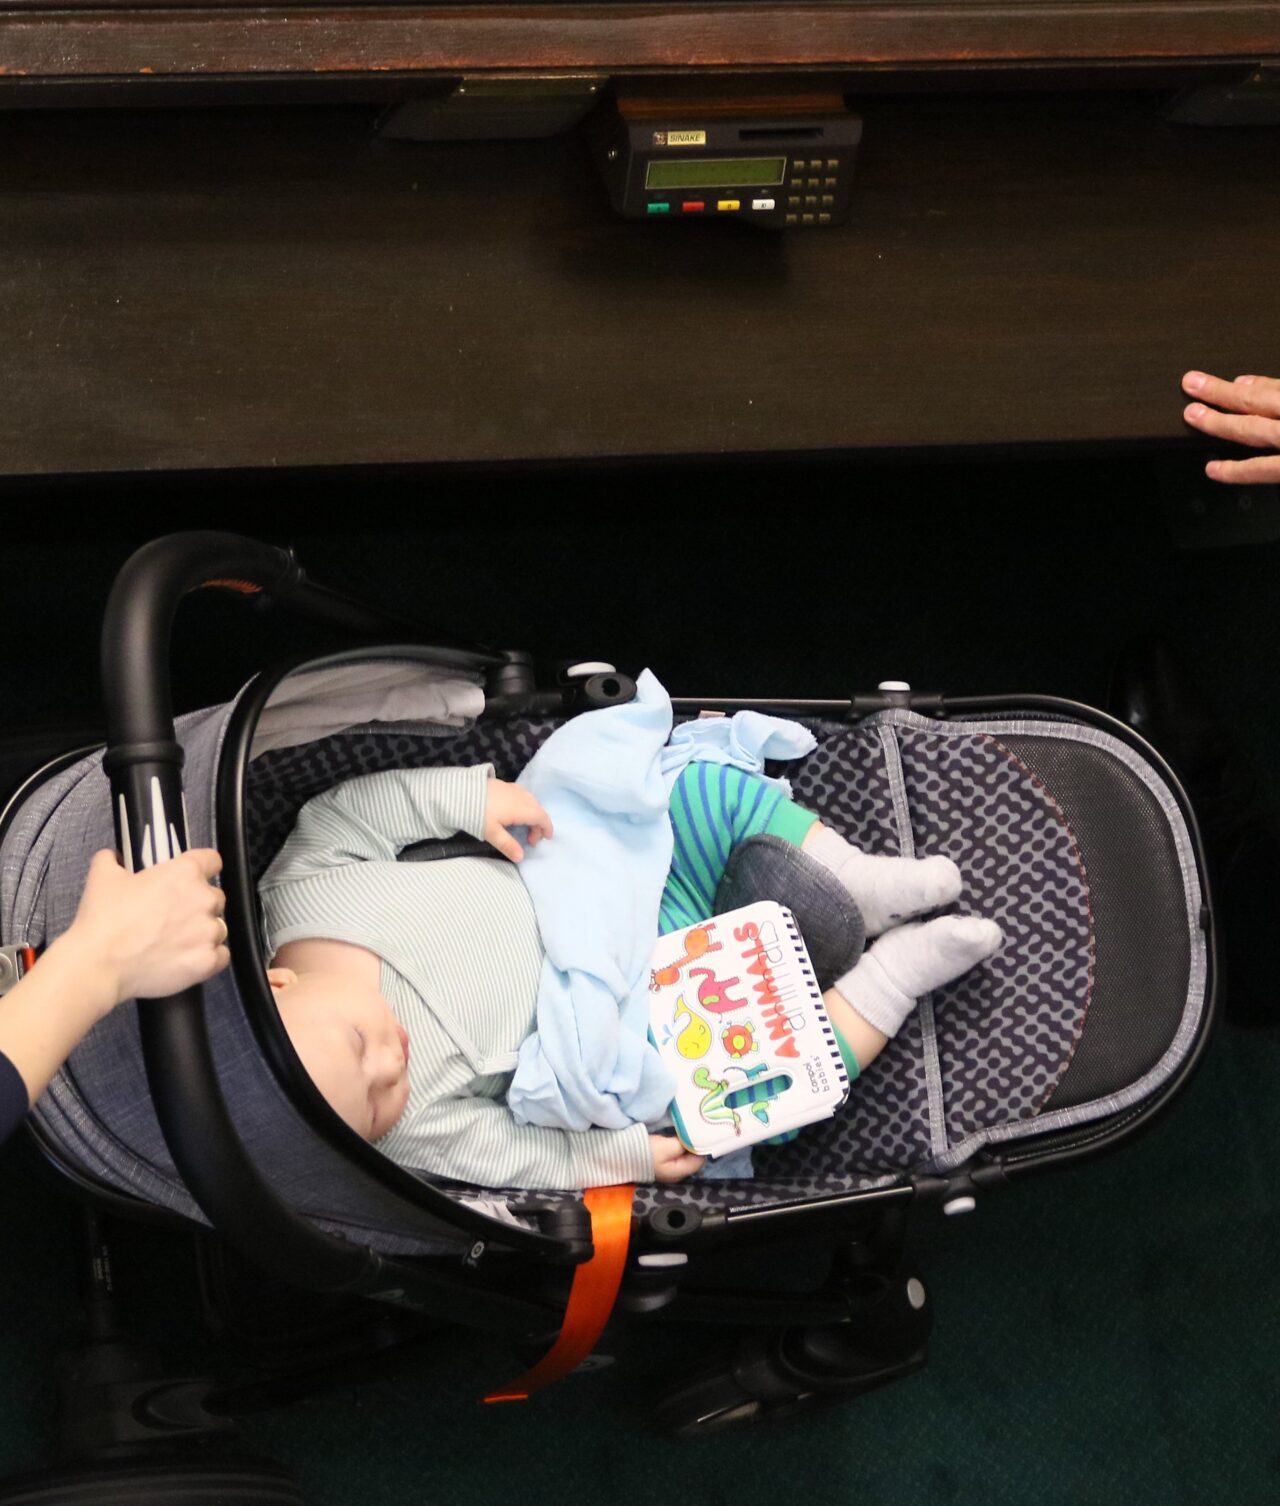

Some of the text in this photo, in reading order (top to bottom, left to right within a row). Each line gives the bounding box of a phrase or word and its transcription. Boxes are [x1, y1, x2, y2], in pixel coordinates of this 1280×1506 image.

[732, 921, 801, 1059] ANIMALS
[803, 1062, 820, 1094] Canpol
[812, 1056, 830, 1093] babies
